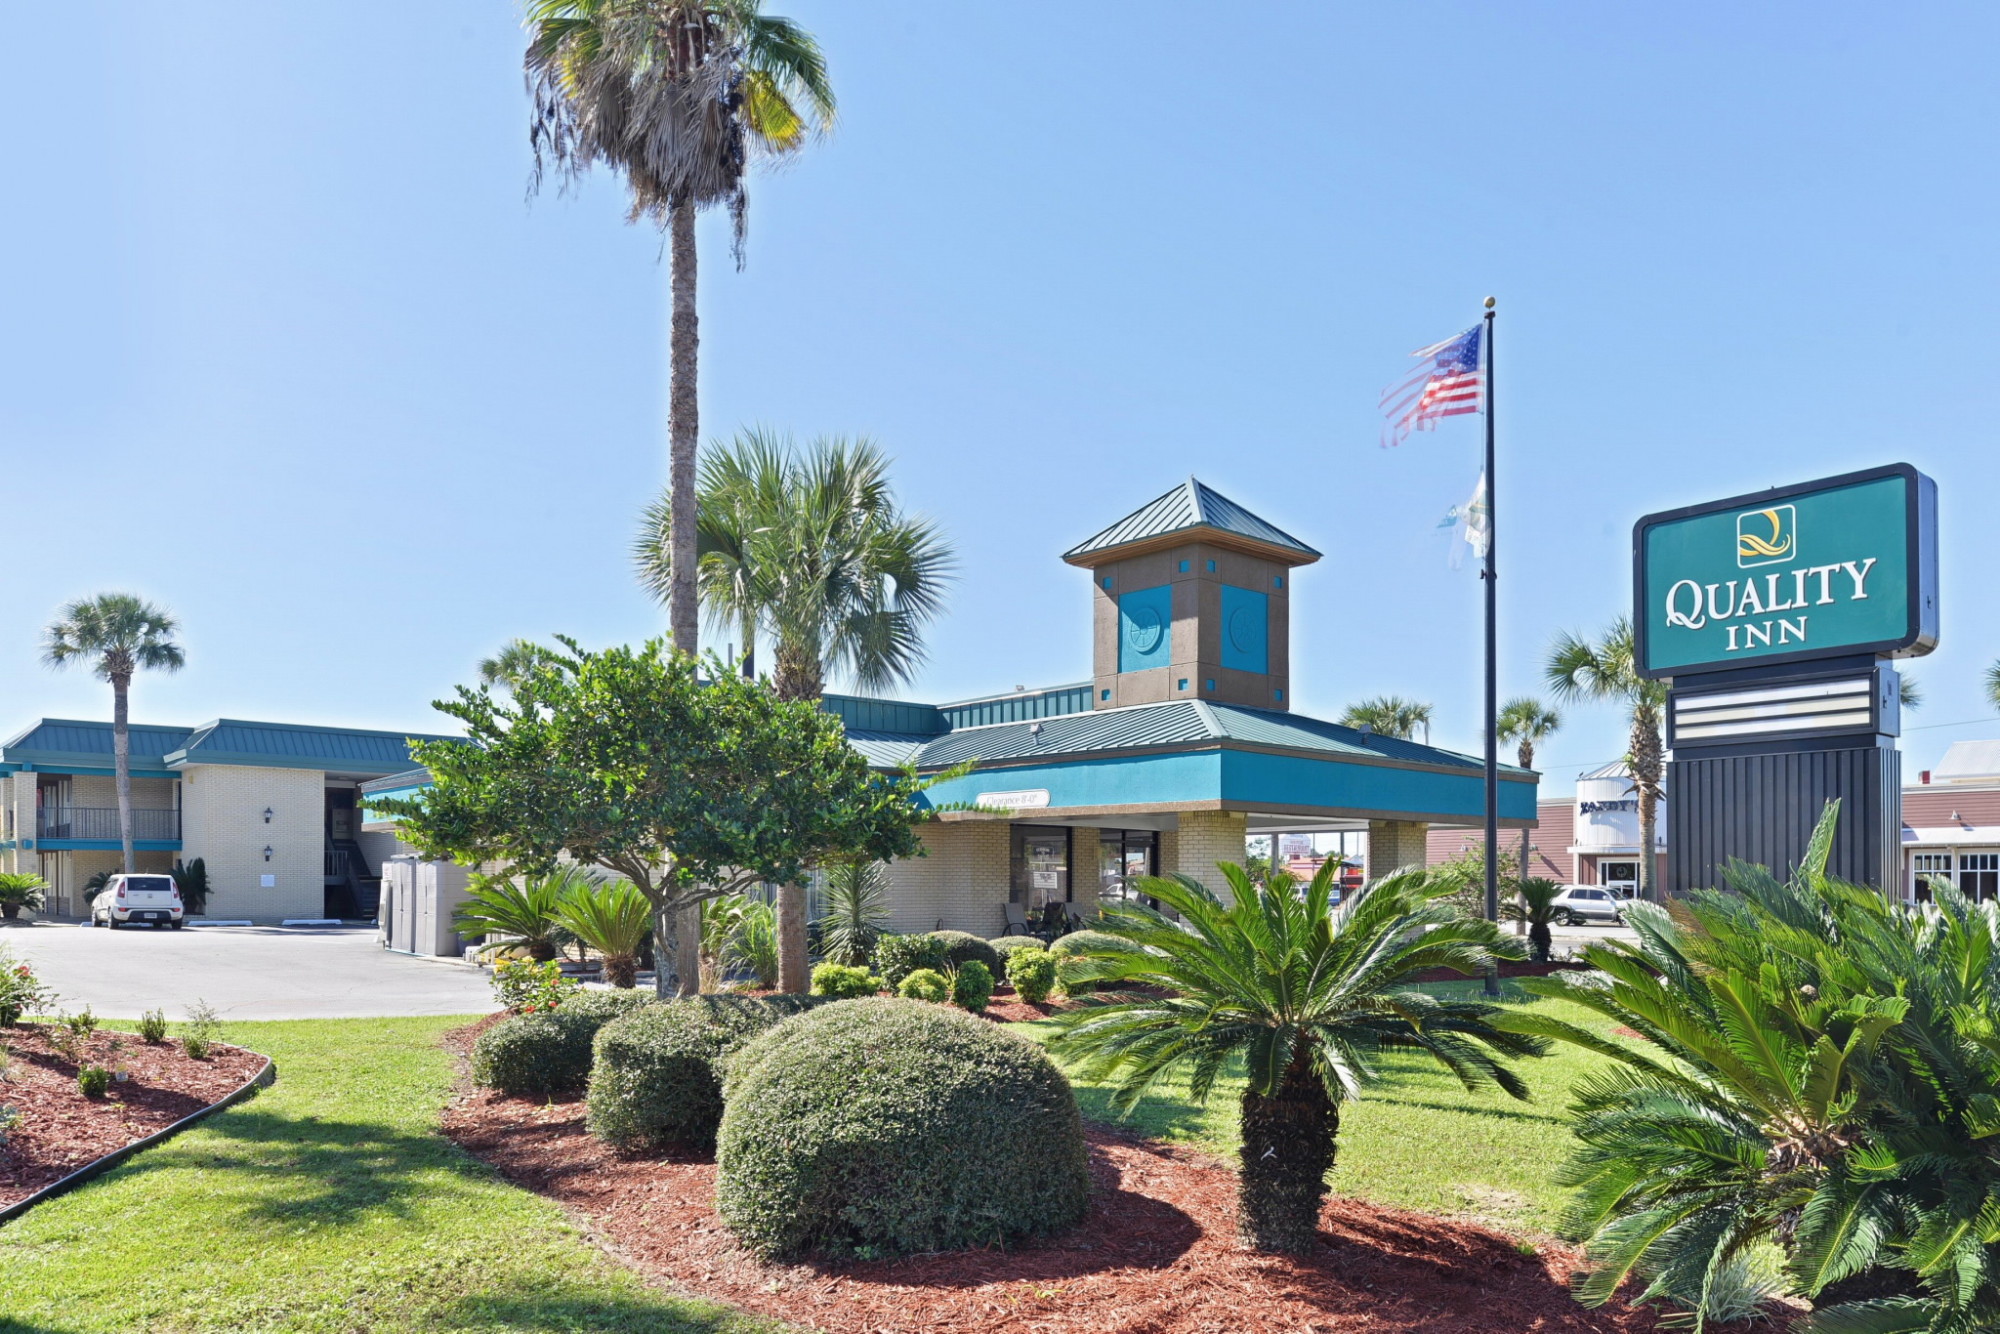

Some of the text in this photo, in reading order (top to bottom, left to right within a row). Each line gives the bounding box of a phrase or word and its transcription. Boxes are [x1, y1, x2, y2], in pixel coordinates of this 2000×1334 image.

[1666, 557, 1877, 629] QUALITY
[1725, 616, 1807, 650] INN
[986, 796, 1020, 805] Clearance
